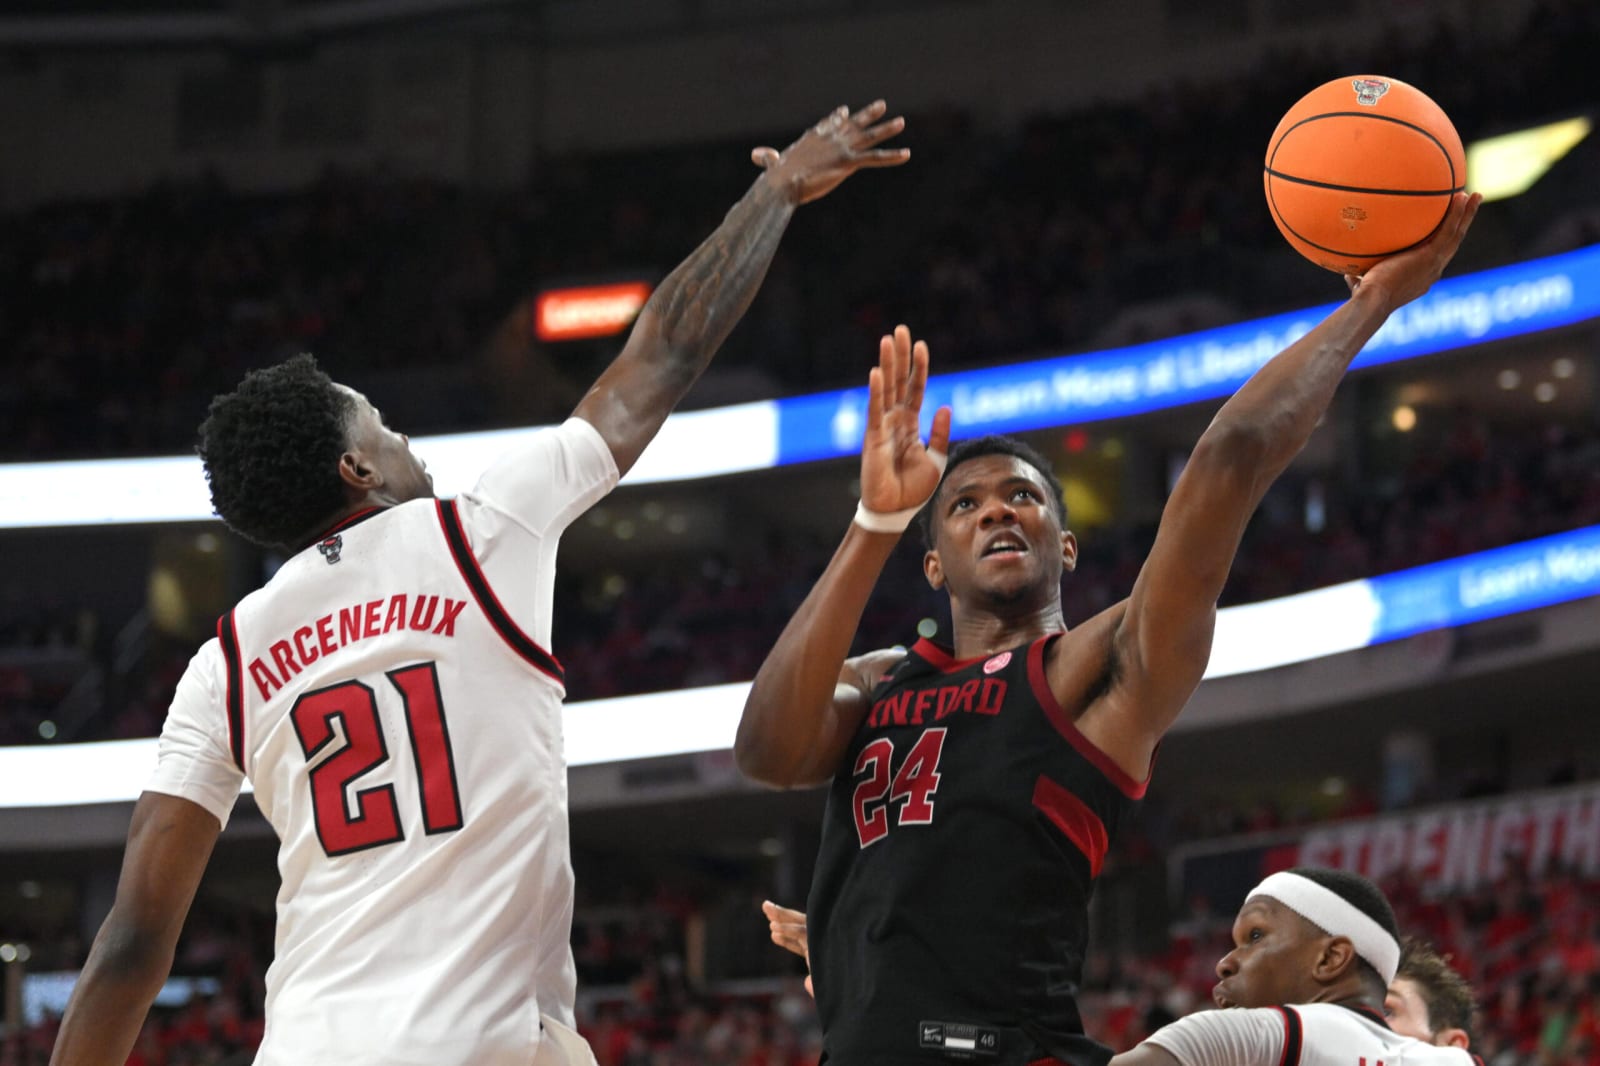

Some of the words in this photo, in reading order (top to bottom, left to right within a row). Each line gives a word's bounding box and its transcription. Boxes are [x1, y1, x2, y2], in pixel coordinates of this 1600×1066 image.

[950, 381, 1050, 426] Learn
[1052, 366, 1142, 410] More
[1458, 556, 1544, 608] Learn
[248, 594, 467, 702] ARCENEAUX
[289, 660, 463, 857] 21
[853, 727, 948, 850] 24
